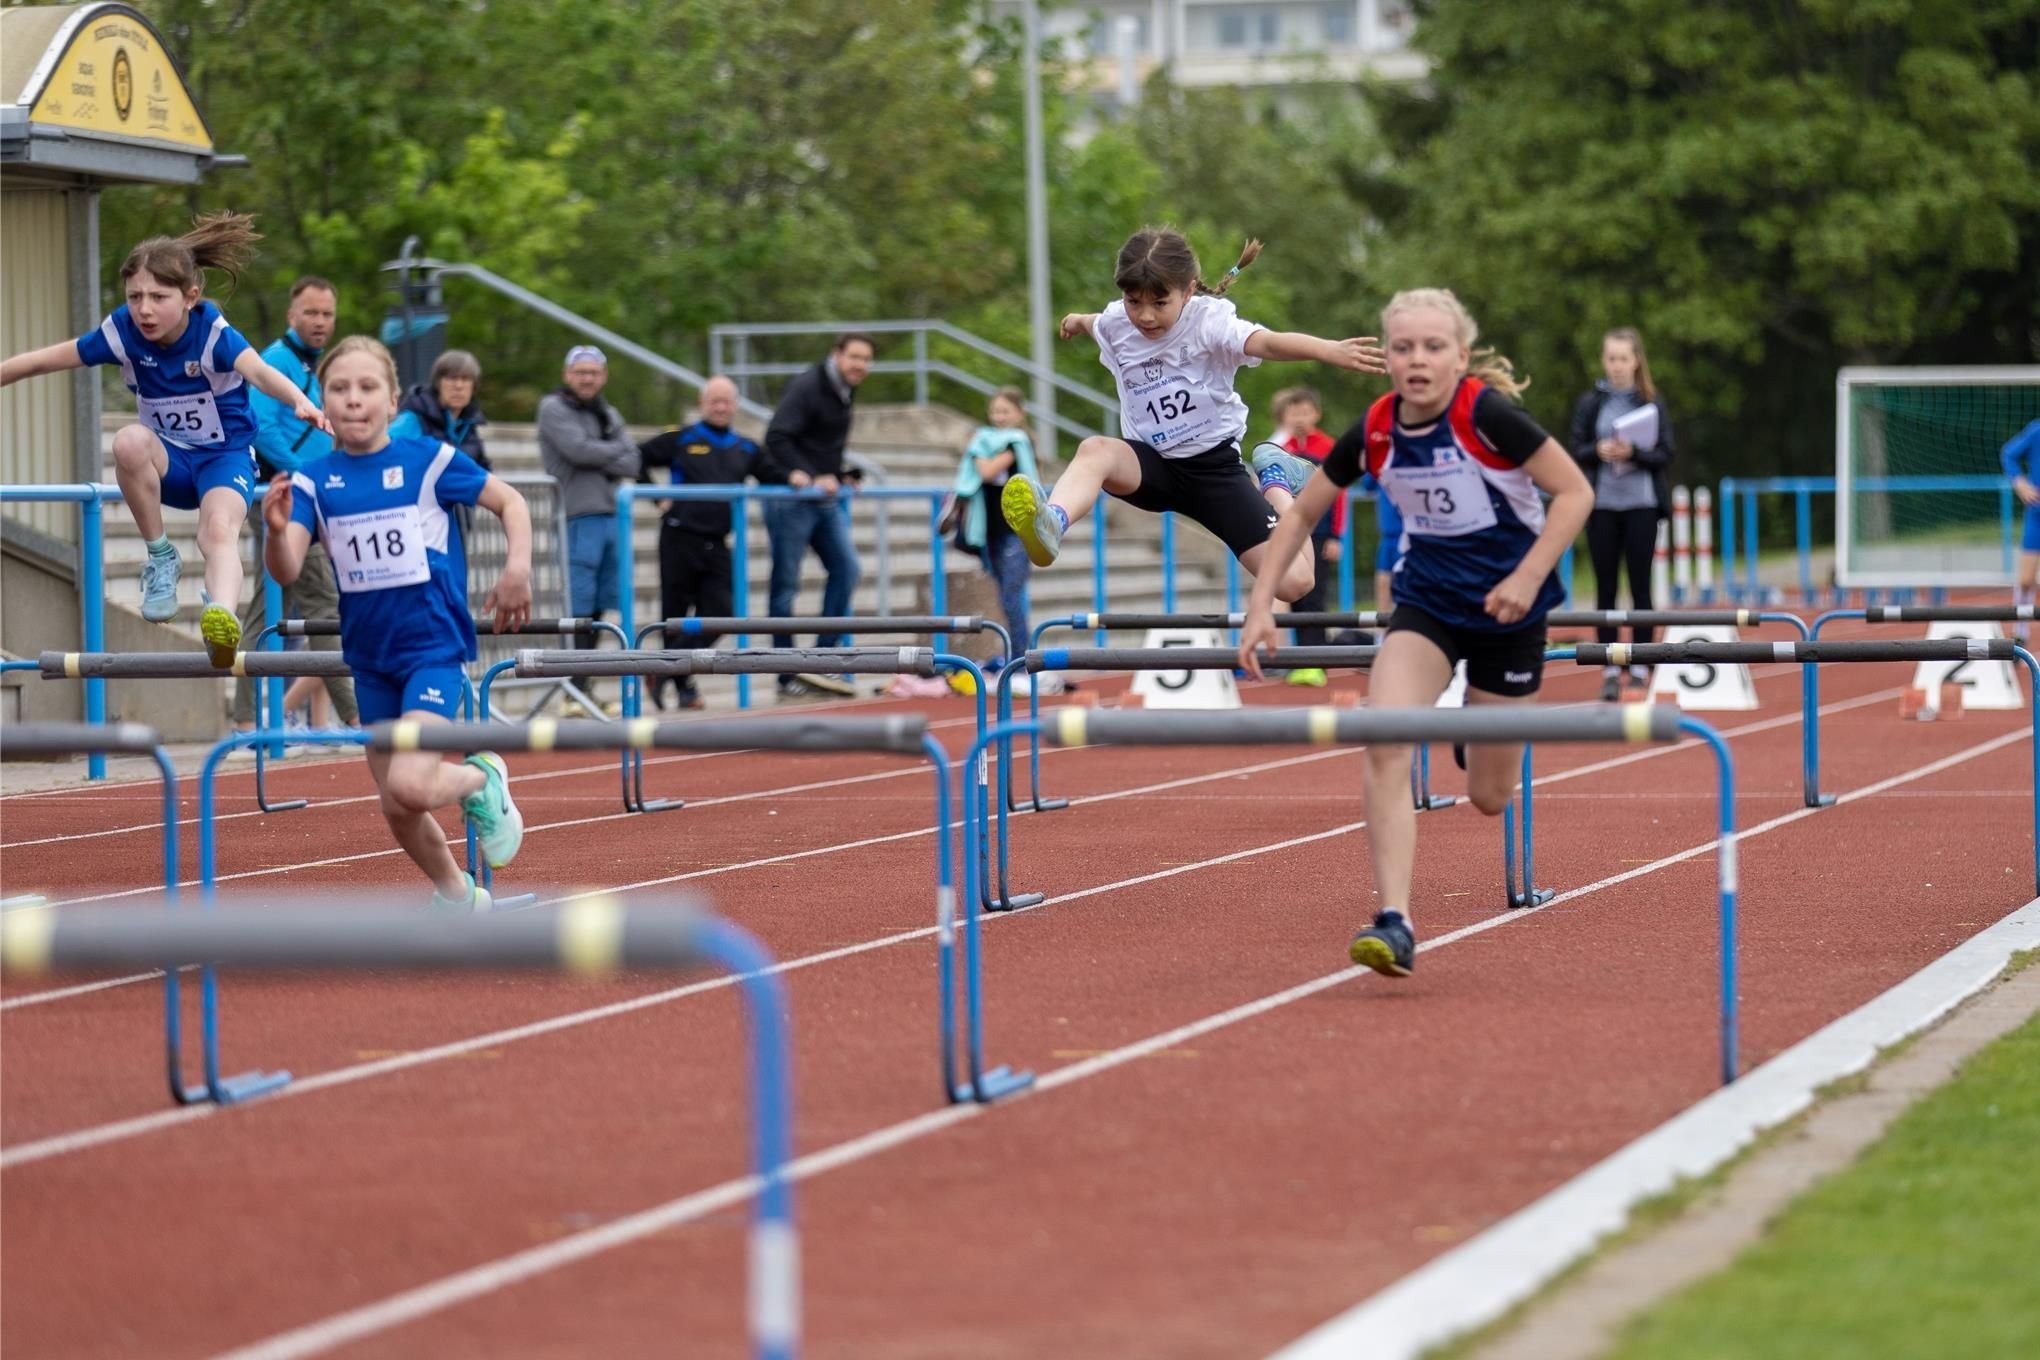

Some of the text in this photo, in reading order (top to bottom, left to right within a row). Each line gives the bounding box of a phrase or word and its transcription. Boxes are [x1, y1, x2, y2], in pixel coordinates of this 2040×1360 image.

[152, 410, 202, 431] 125
[1146, 389, 1197, 424] 152
[1414, 487, 1456, 514] 73
[347, 529, 404, 562] 118
